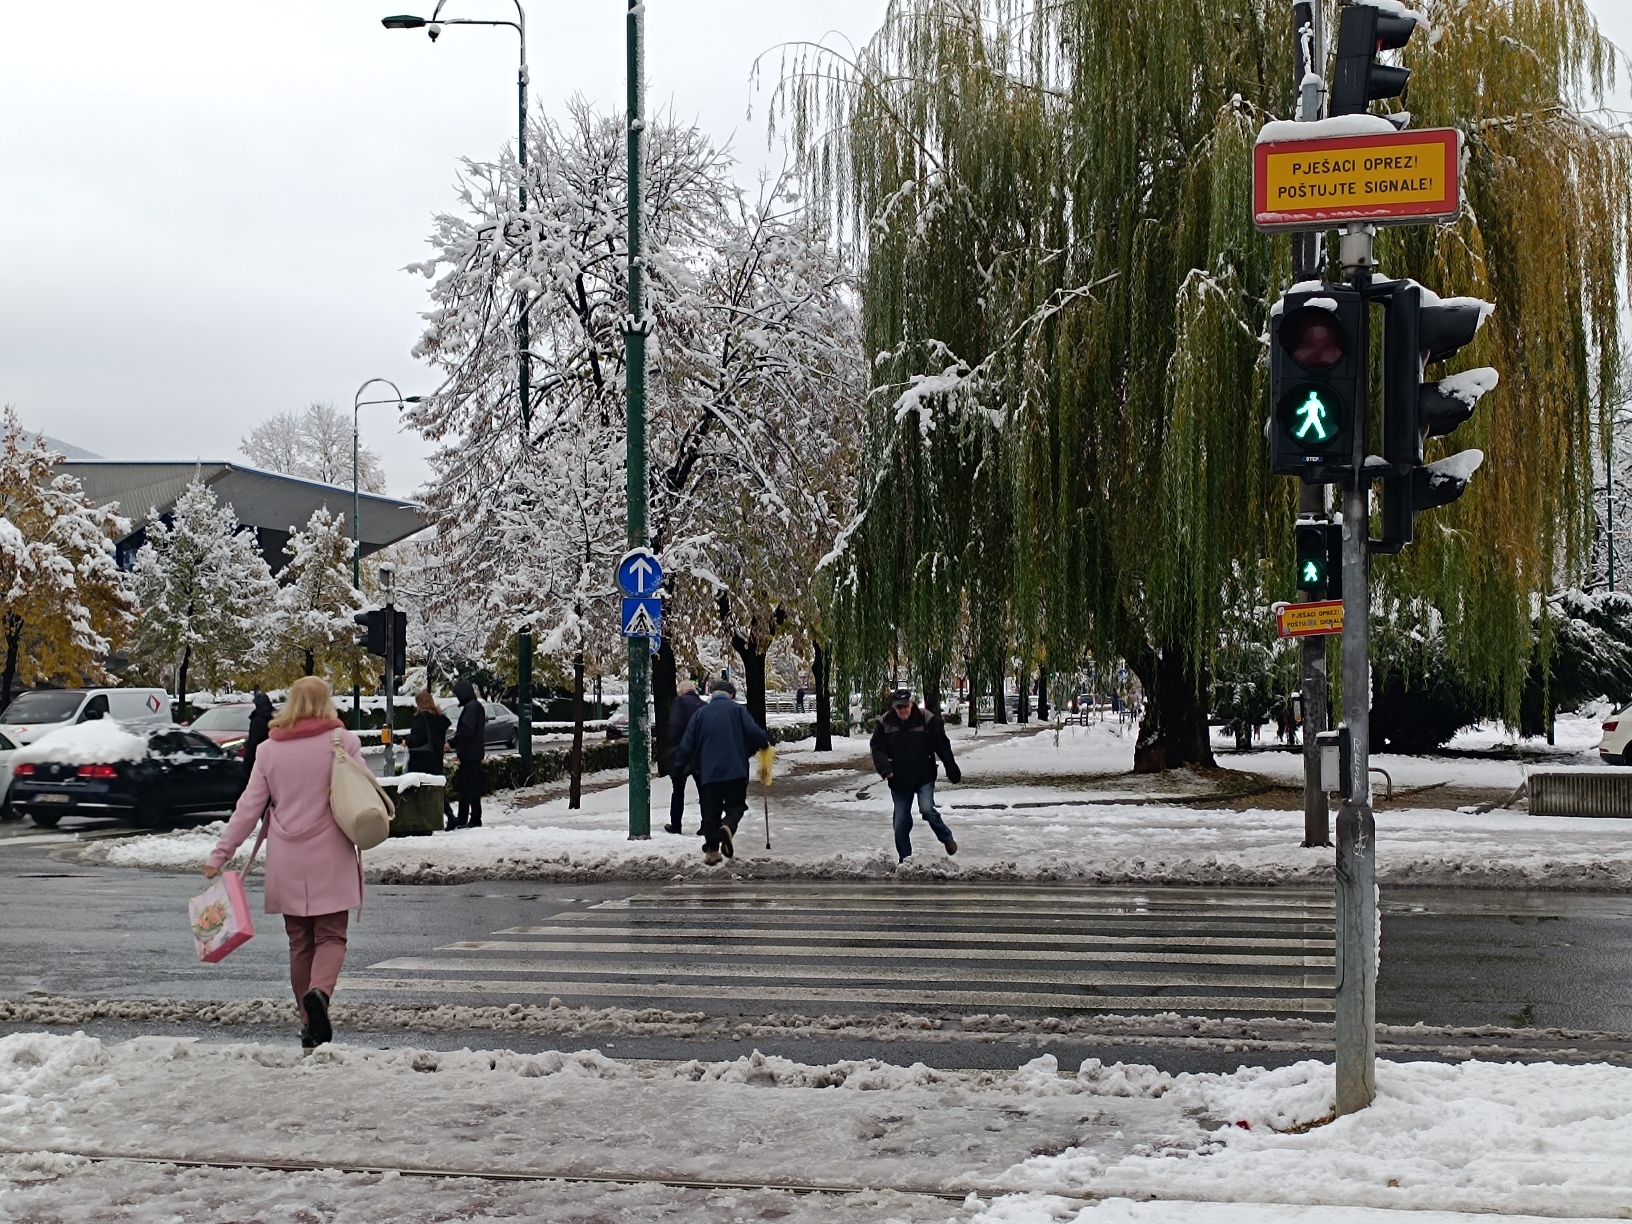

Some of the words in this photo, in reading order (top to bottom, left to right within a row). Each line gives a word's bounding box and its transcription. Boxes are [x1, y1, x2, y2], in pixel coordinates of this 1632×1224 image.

[1292, 159, 1356, 175] PJEŠACI
[1363, 156, 1418, 171] OPREZ!
[1278, 182, 1356, 199] POŠTUJTE
[1364, 177, 1433, 194] SIGNALE!
